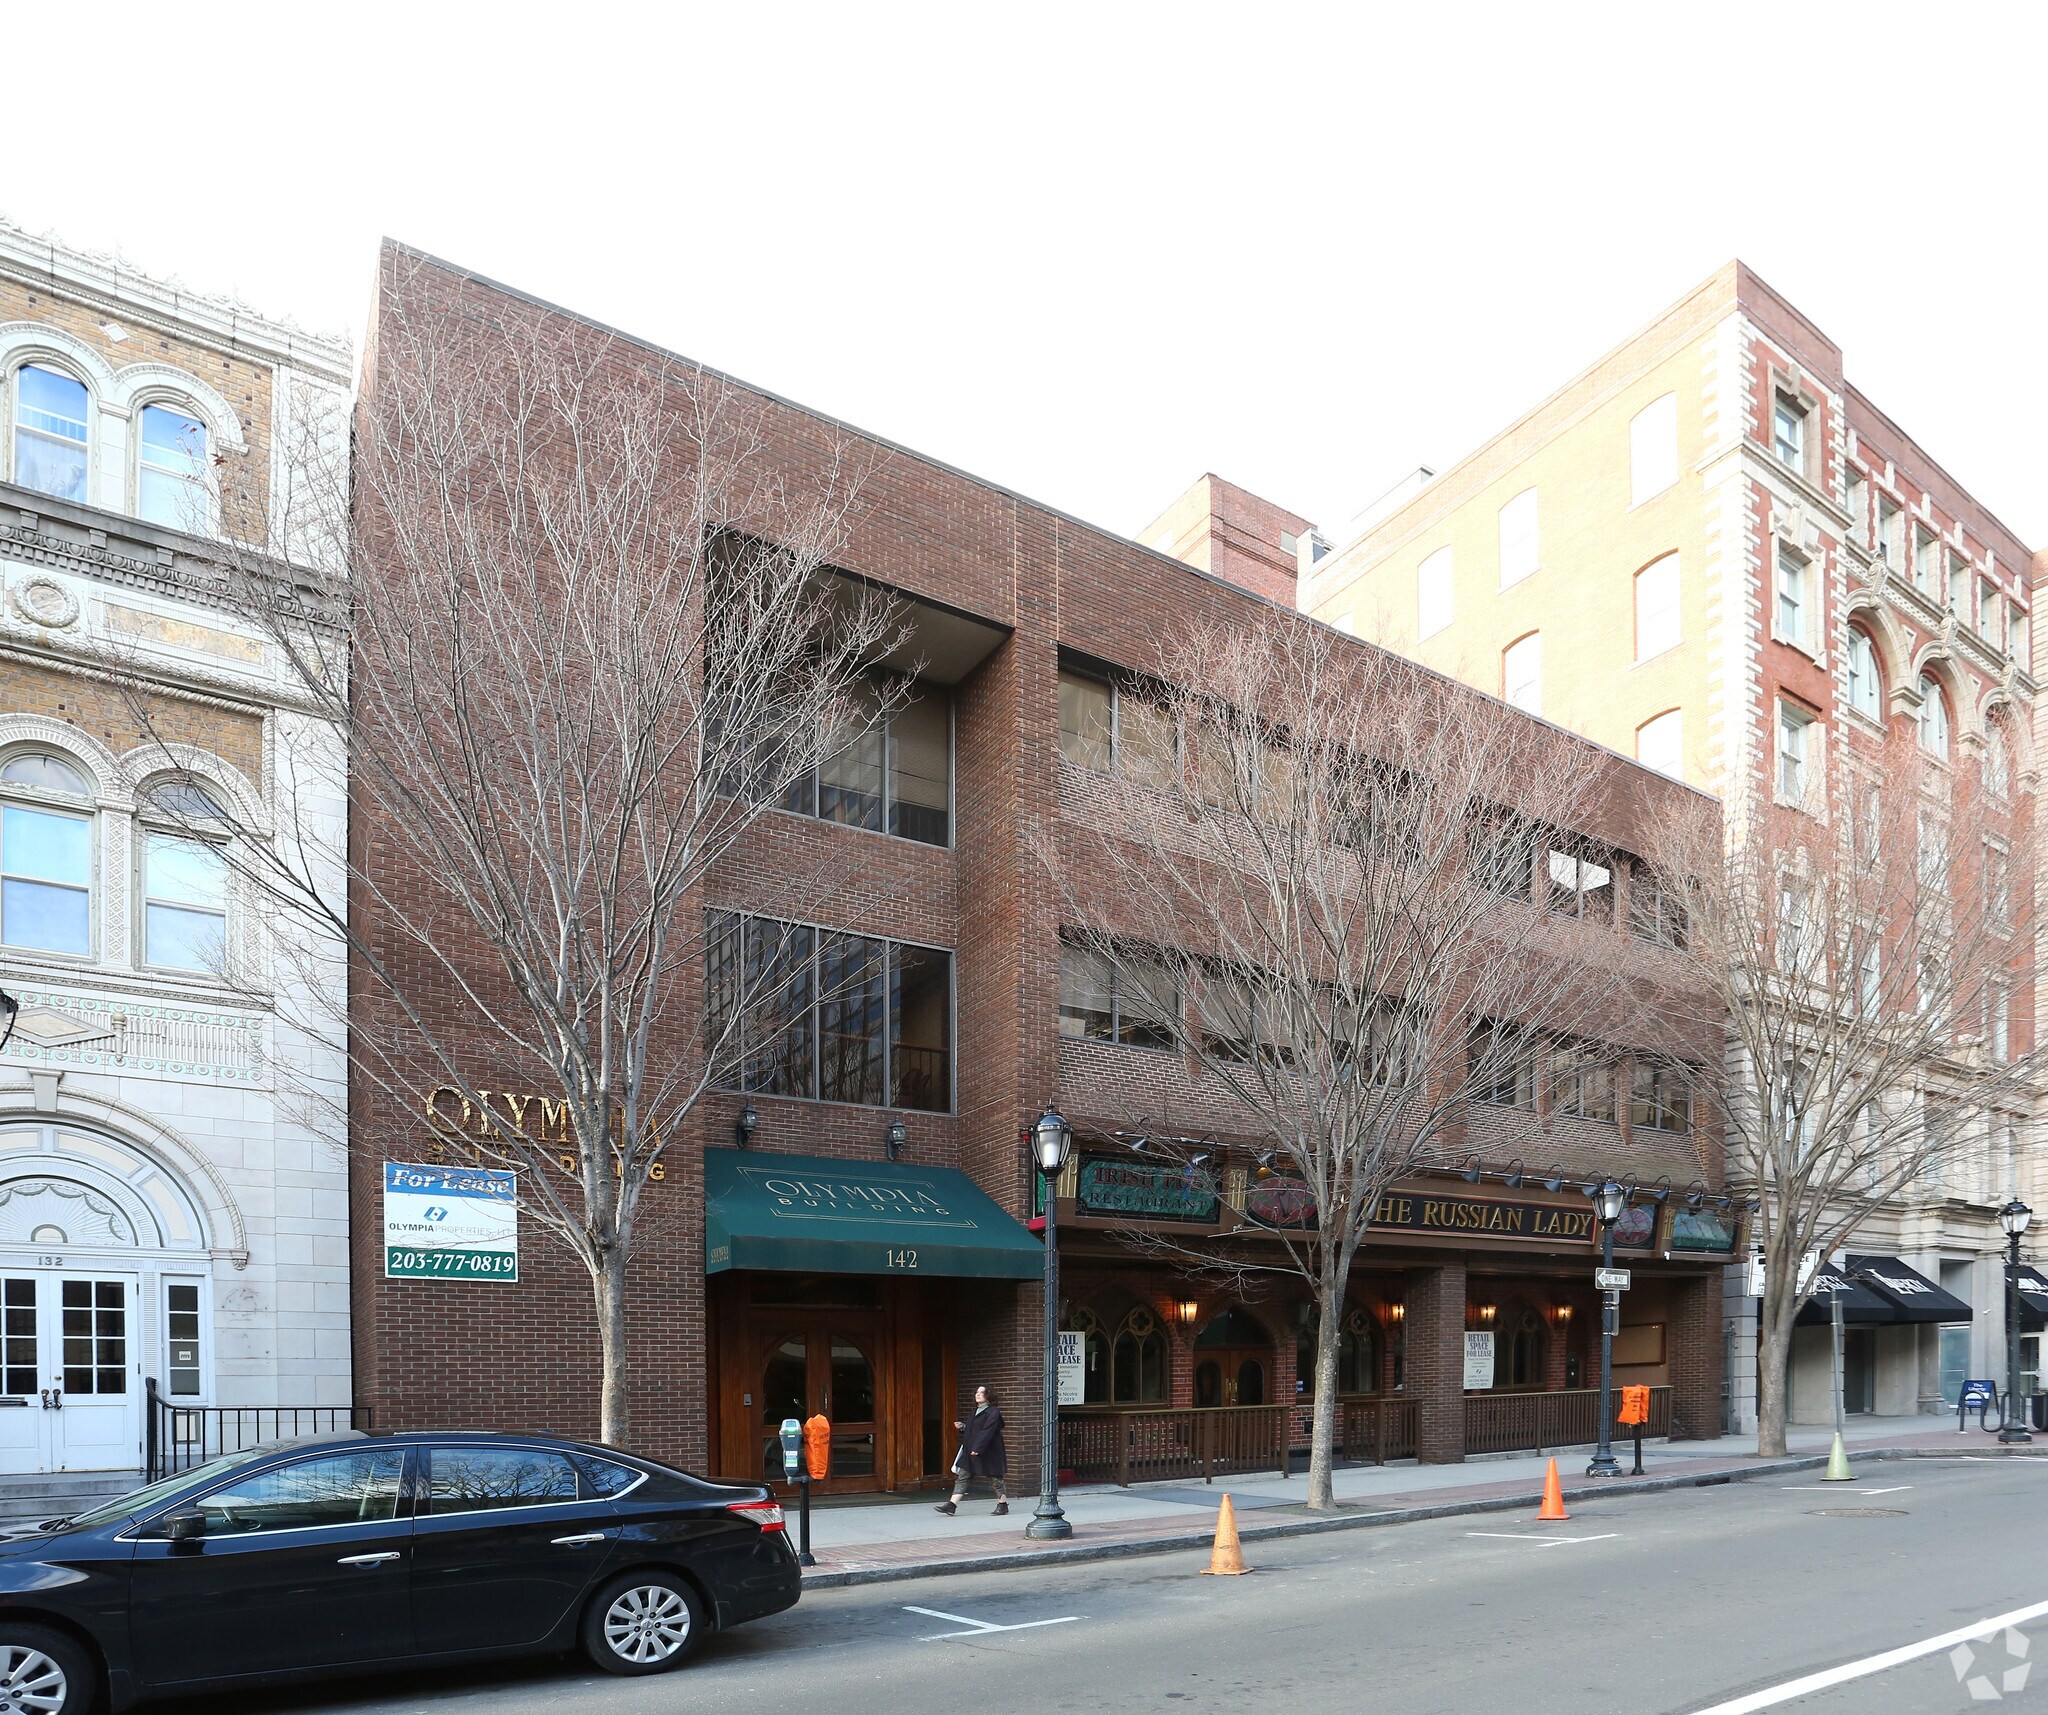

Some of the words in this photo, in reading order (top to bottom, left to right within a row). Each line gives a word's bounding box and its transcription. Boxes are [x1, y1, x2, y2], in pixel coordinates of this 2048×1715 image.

[426, 1085, 664, 1148] OLYMIA
[391, 1168, 436, 1188] For
[440, 1172, 510, 1193] Lease
[1095, 1167, 1155, 1189] IRISH
[764, 1179, 940, 1205] OLYMPIA
[1090, 1191, 1208, 1211] RESTAURANT
[778, 1197, 950, 1216] BUILDING
[388, 1222, 434, 1232] OLYMPIA
[1421, 1200, 1524, 1231] RUSSIAN
[1531, 1209, 1593, 1236] LADY
[37, 1256, 64, 1267] 132
[390, 1252, 515, 1273] 203-777-0819
[885, 1249, 918, 1269] 142
[1602, 1274, 1612, 1283] ONE
[1614, 1275, 1625, 1283] WAY
[1468, 1333, 1489, 1342] RETAIL
[1470, 1342, 1488, 1350] SPACE
